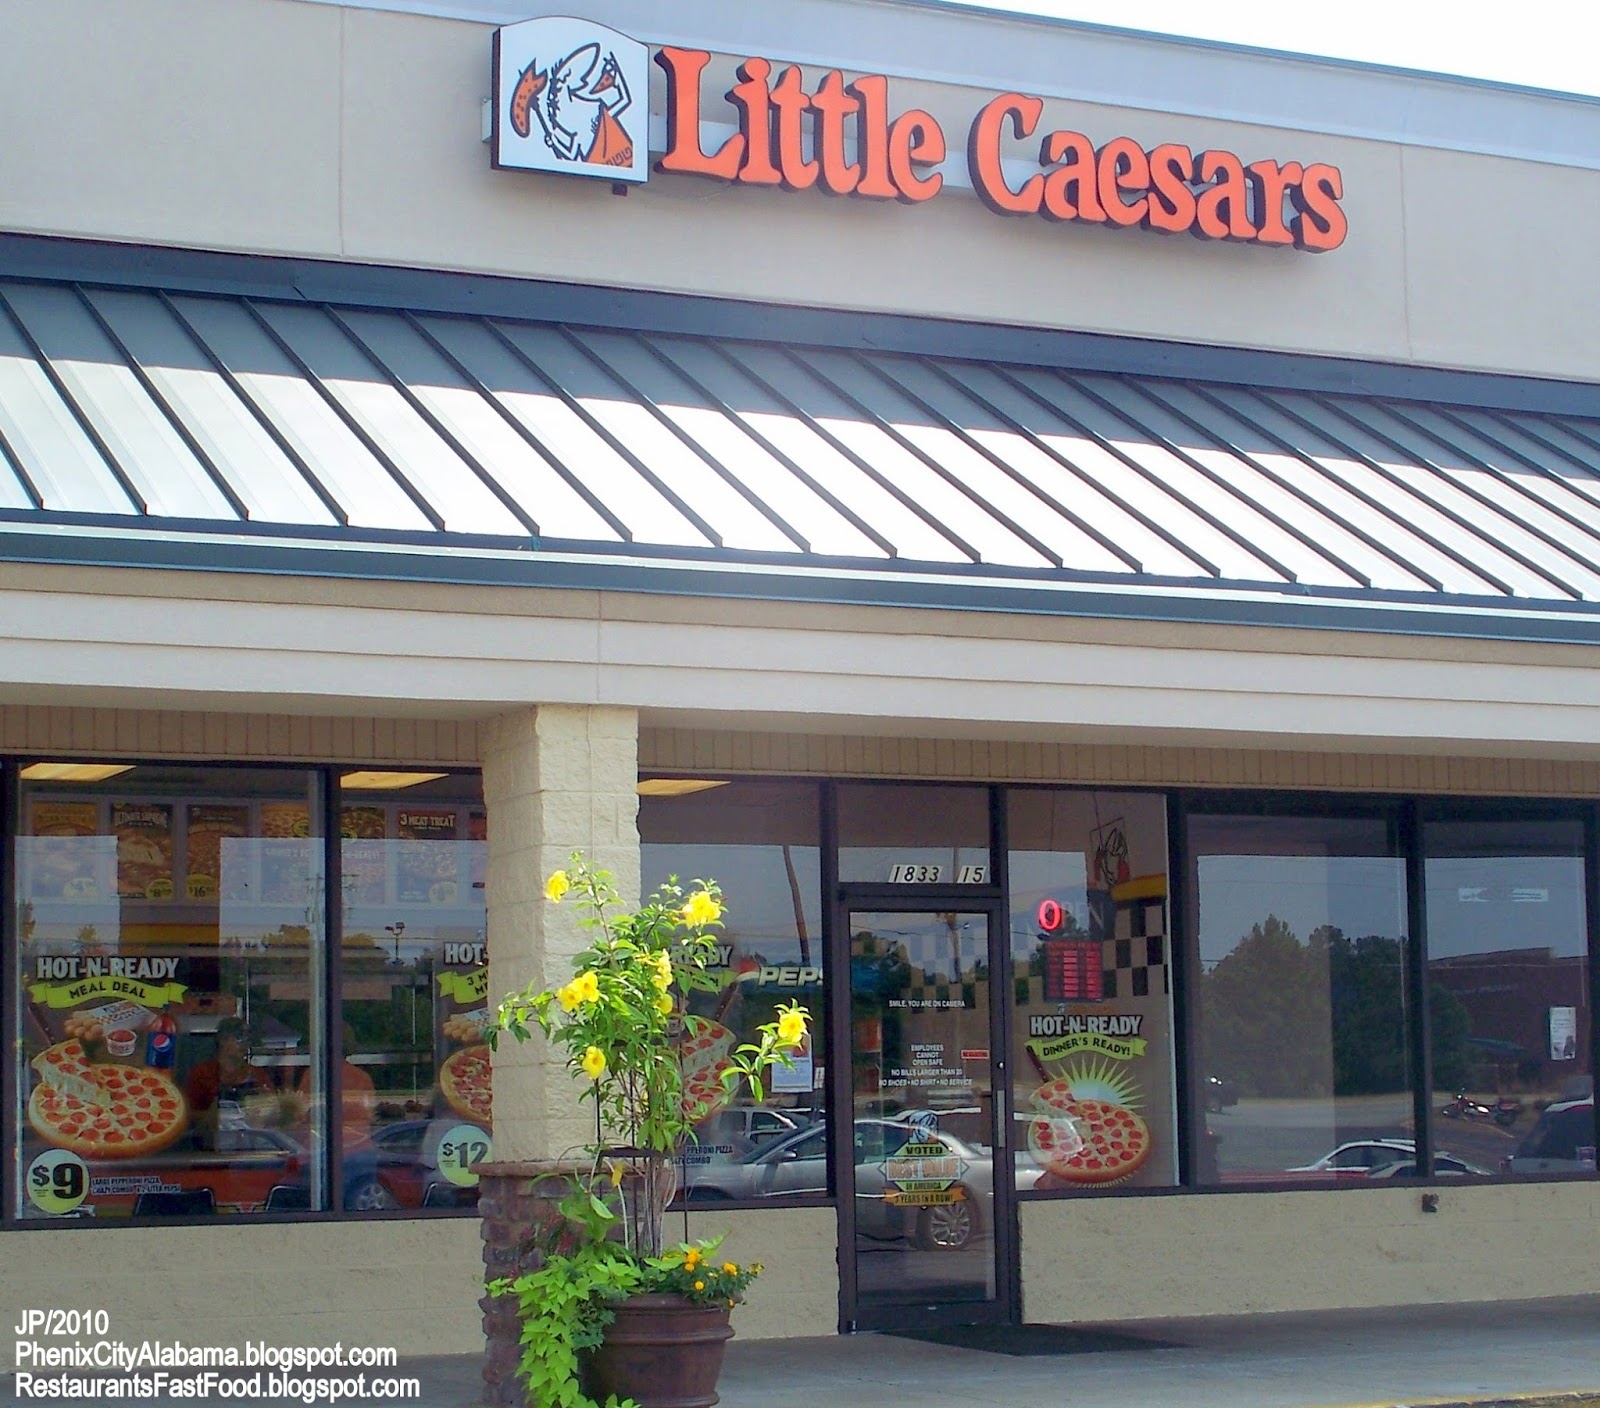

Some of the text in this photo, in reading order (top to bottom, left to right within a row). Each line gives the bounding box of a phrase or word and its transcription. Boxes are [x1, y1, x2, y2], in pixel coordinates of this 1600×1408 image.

[655, 46, 1348, 253] Little Caesars
[893, 866, 985, 883] 1833 15
[36, 956, 181, 980] HOT-N-READY
[69, 981, 146, 999] MEAL DEAL
[1030, 1015, 1142, 1035] HOT-N-READY
[1043, 1037, 1130, 1056] DINNER'S READY!
[442, 1142, 488, 1168] $12
[906, 1146, 942, 1154] VOTED
[32, 1163, 83, 1199] $9
